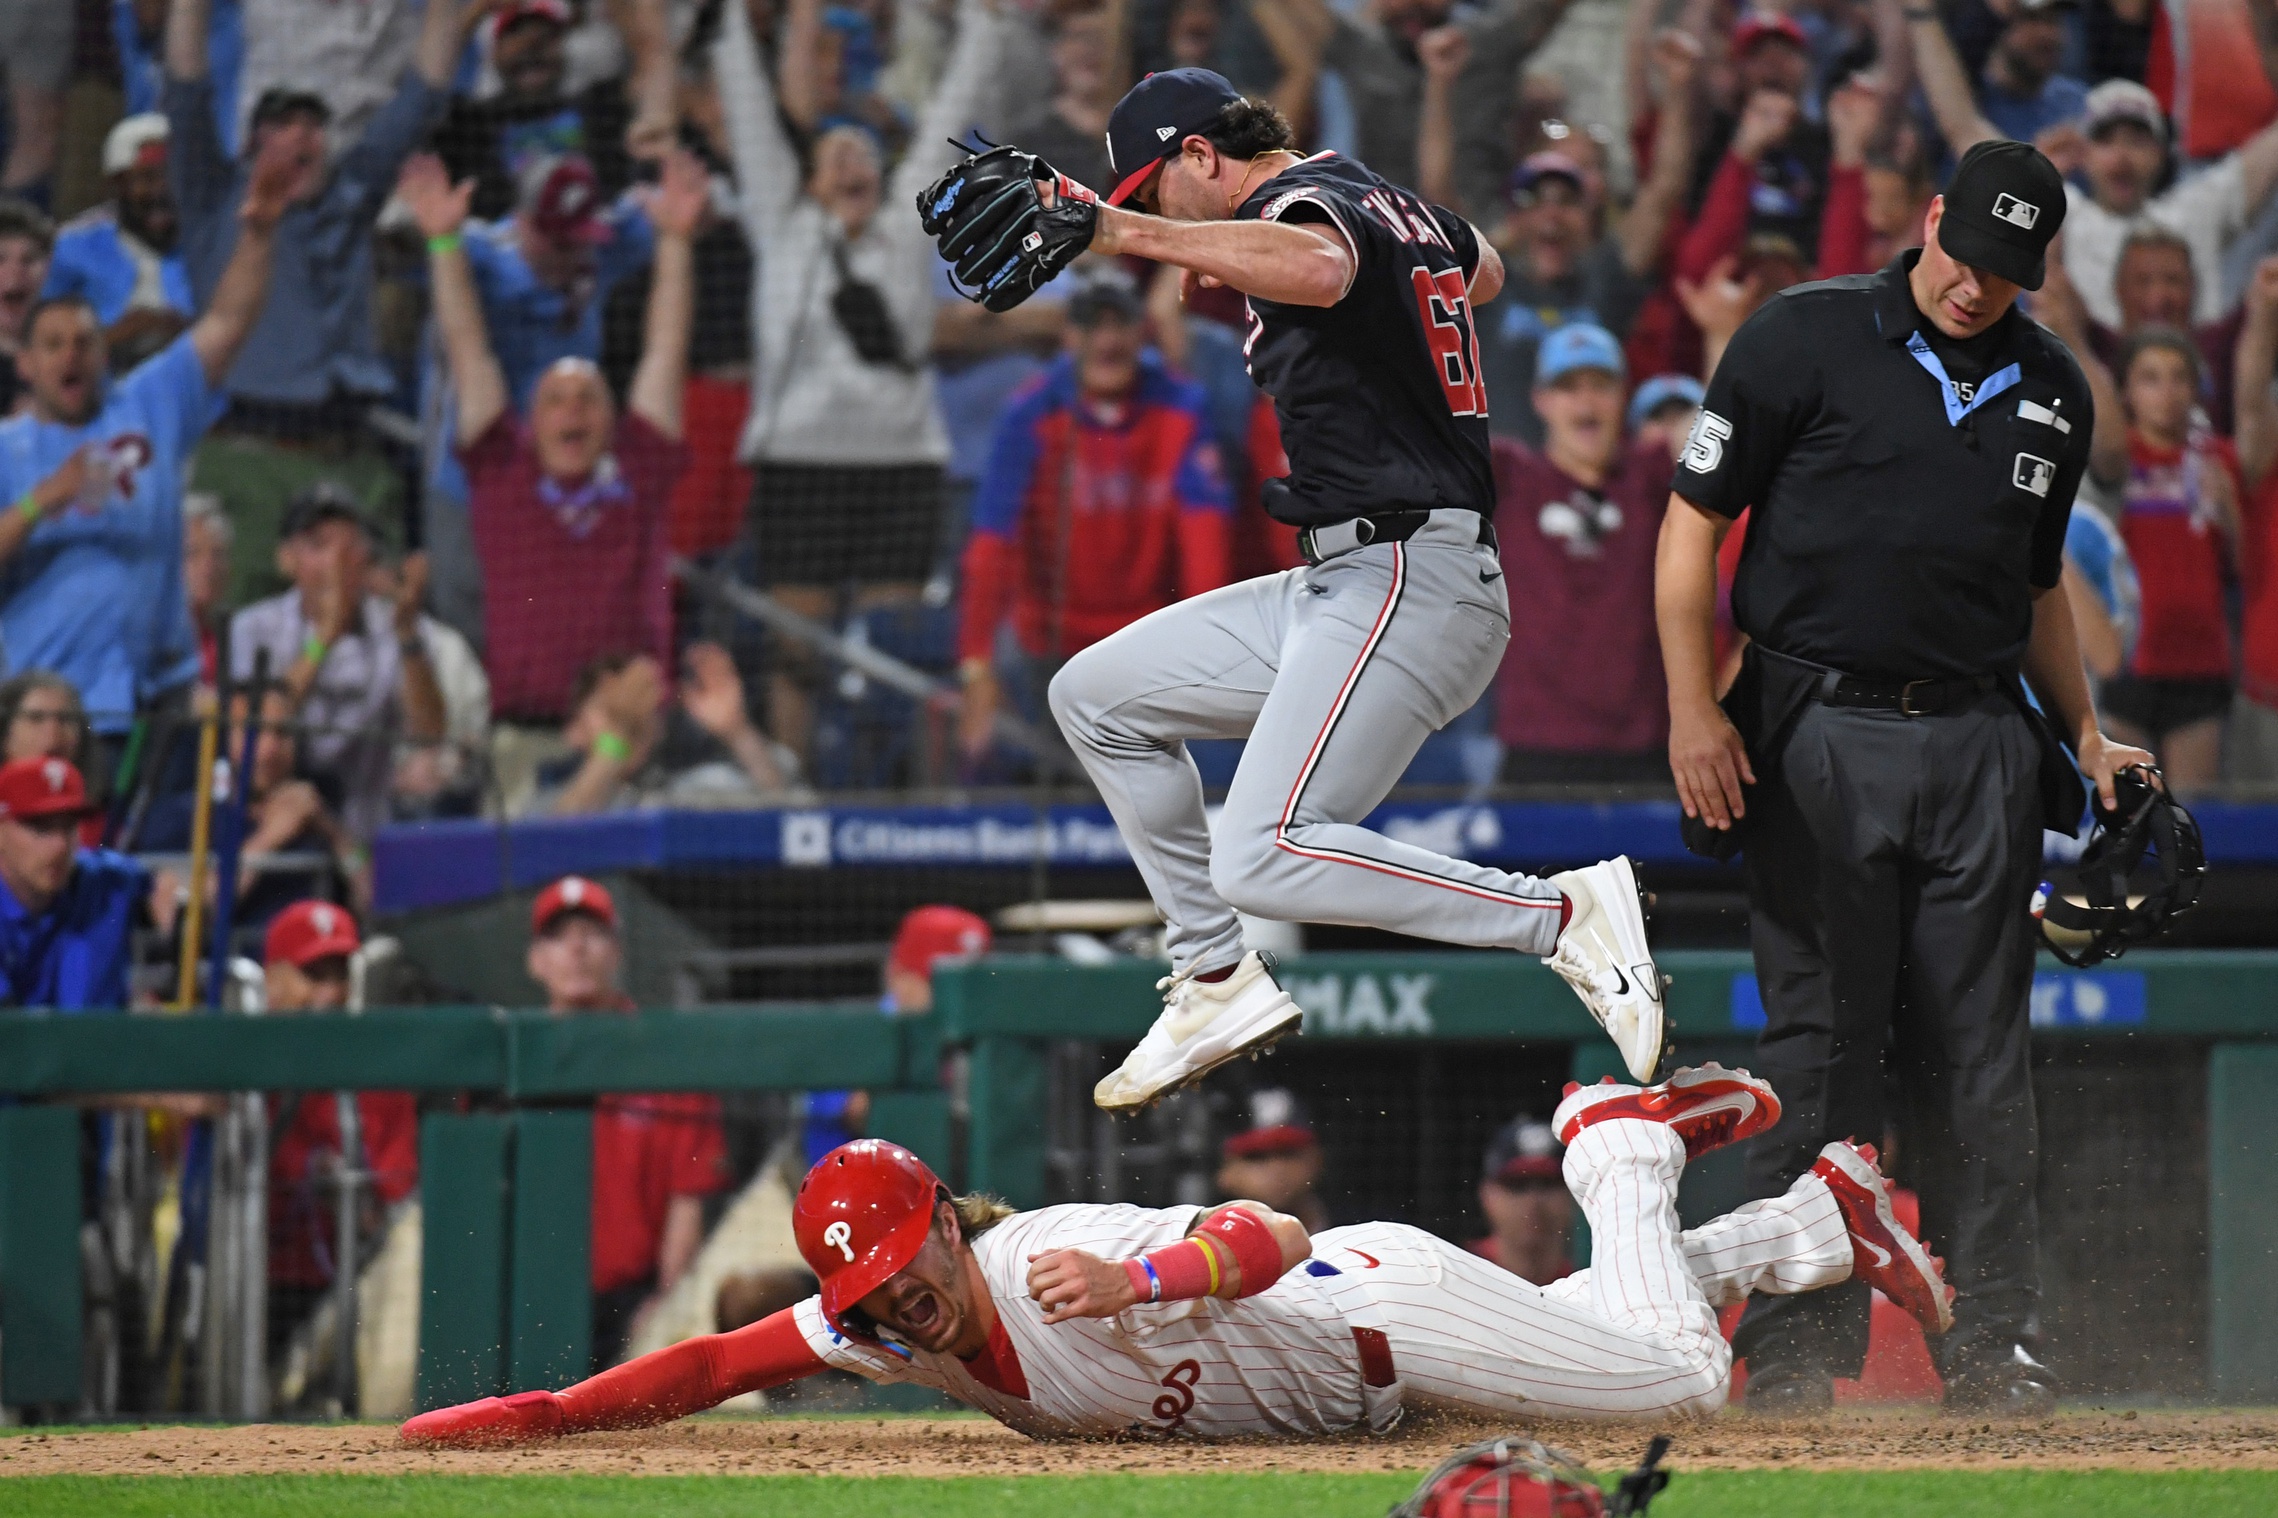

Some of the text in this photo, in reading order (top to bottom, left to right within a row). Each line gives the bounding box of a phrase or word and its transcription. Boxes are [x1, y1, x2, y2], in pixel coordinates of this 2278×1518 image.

[1677, 405, 1733, 474] 5
[1279, 974, 1434, 1034] MAX
[824, 1221, 855, 1262] P
